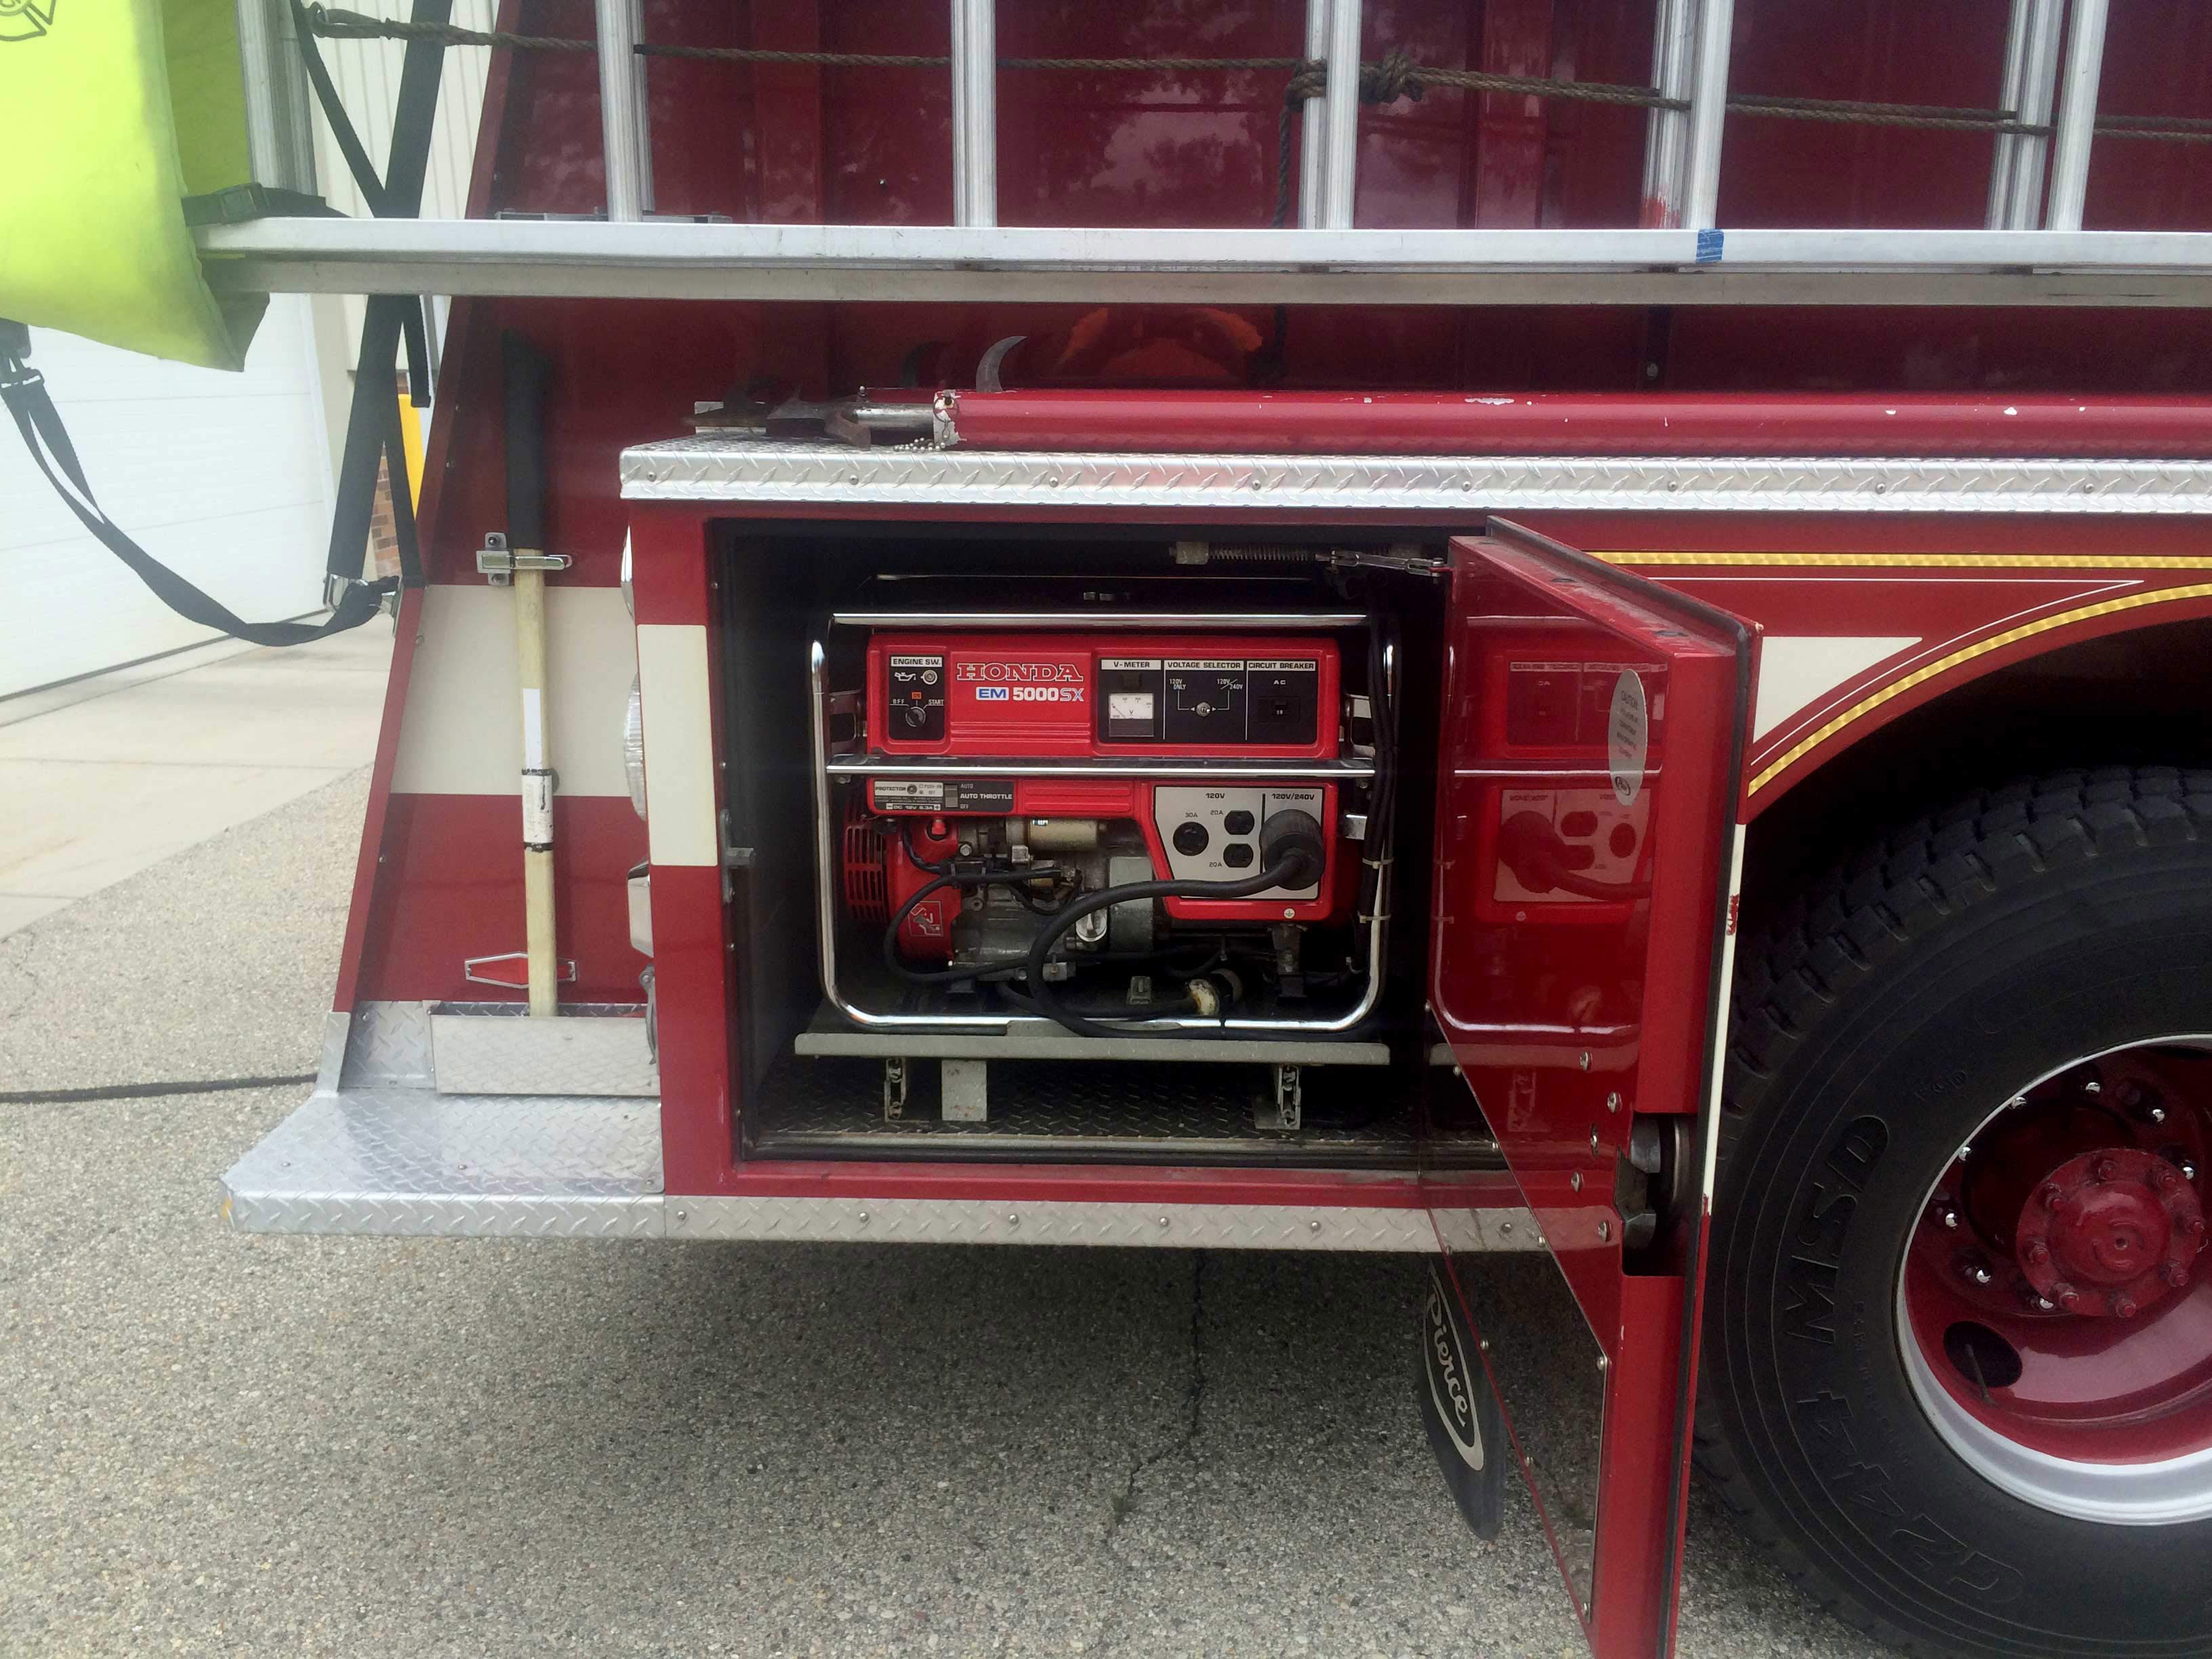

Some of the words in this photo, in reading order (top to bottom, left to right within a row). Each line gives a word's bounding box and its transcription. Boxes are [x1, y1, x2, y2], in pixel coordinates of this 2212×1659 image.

[956, 662, 1084, 682] HONDA
[978, 689, 1006, 699] EM
[1012, 687, 1084, 701] 5000SX
[1785, 1114, 1891, 1347] MSD
[1426, 1284, 1468, 1428] Pierce
